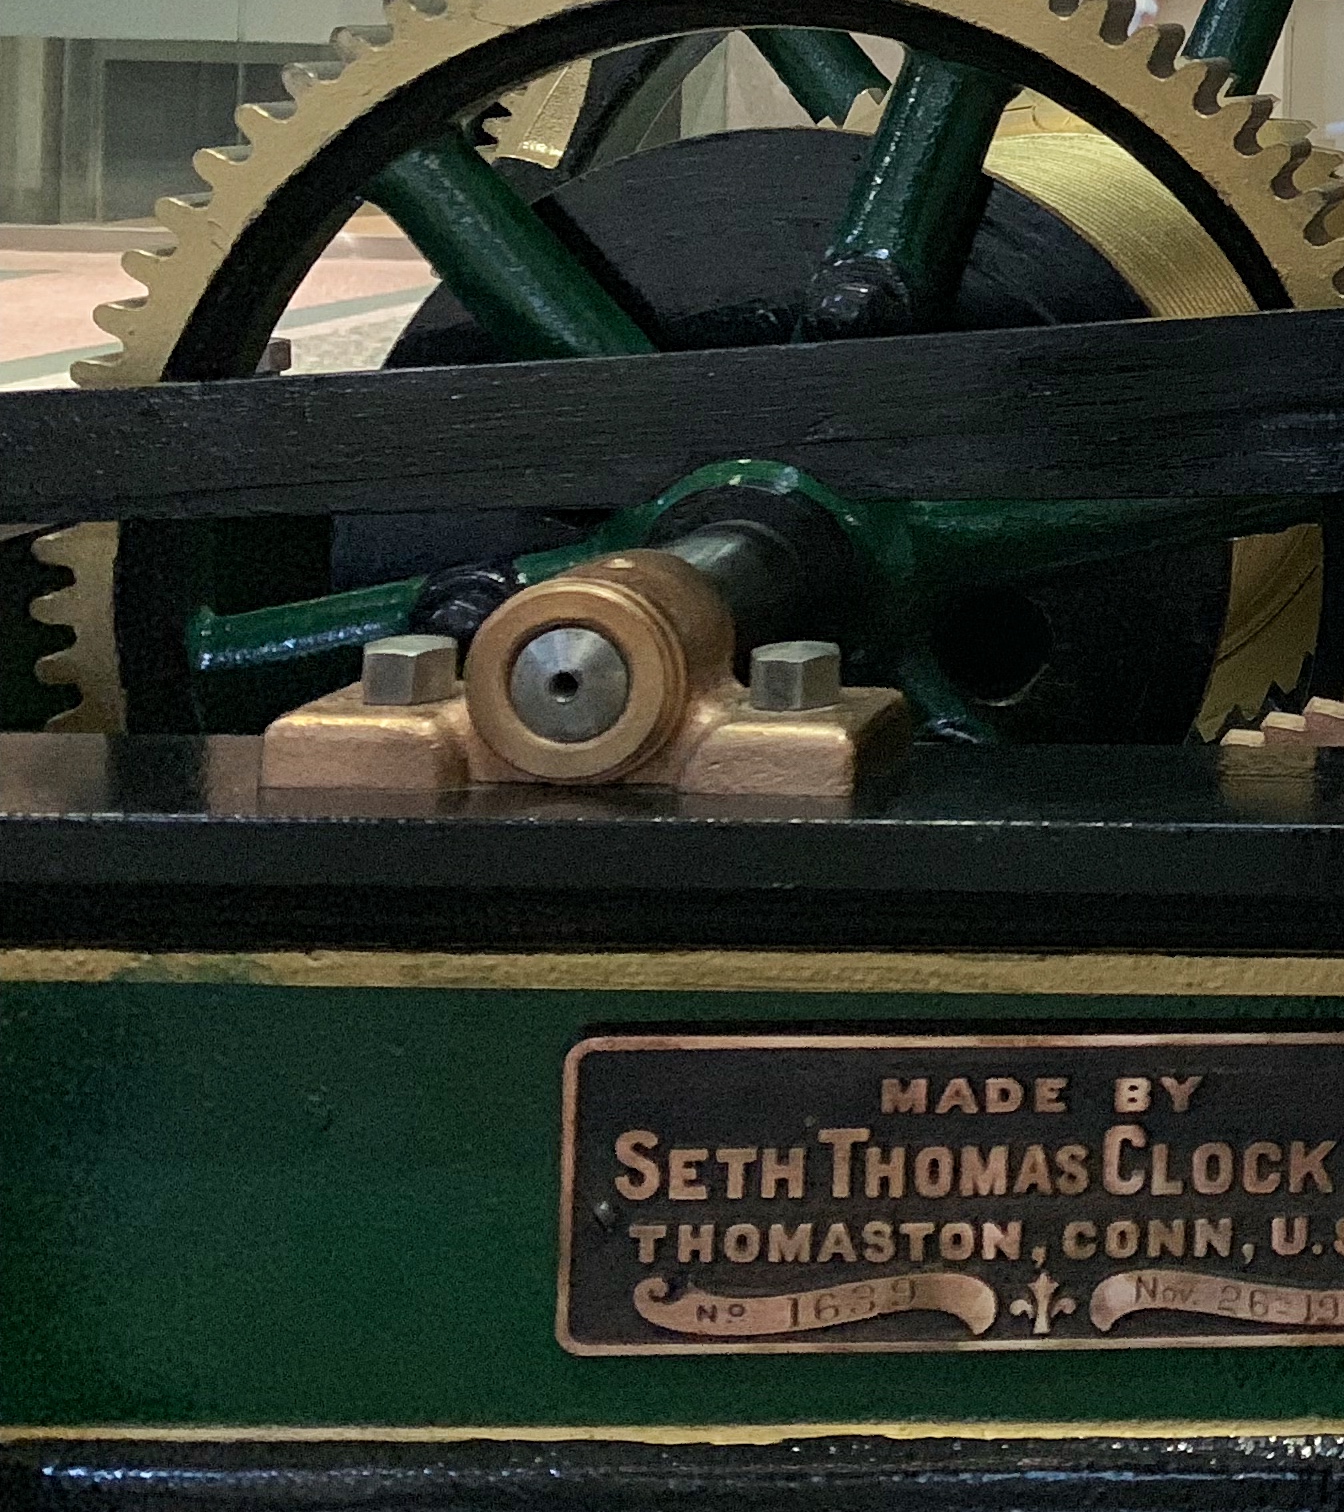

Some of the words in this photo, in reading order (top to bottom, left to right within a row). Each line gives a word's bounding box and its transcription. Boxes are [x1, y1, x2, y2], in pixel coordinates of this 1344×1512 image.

[881, 1076, 1068, 1115] MADE
[1113, 1074, 1203, 1114] BY
[628, 1219, 1047, 1265] THOMASTON,
[1061, 1215, 1256, 1265] CONN,
